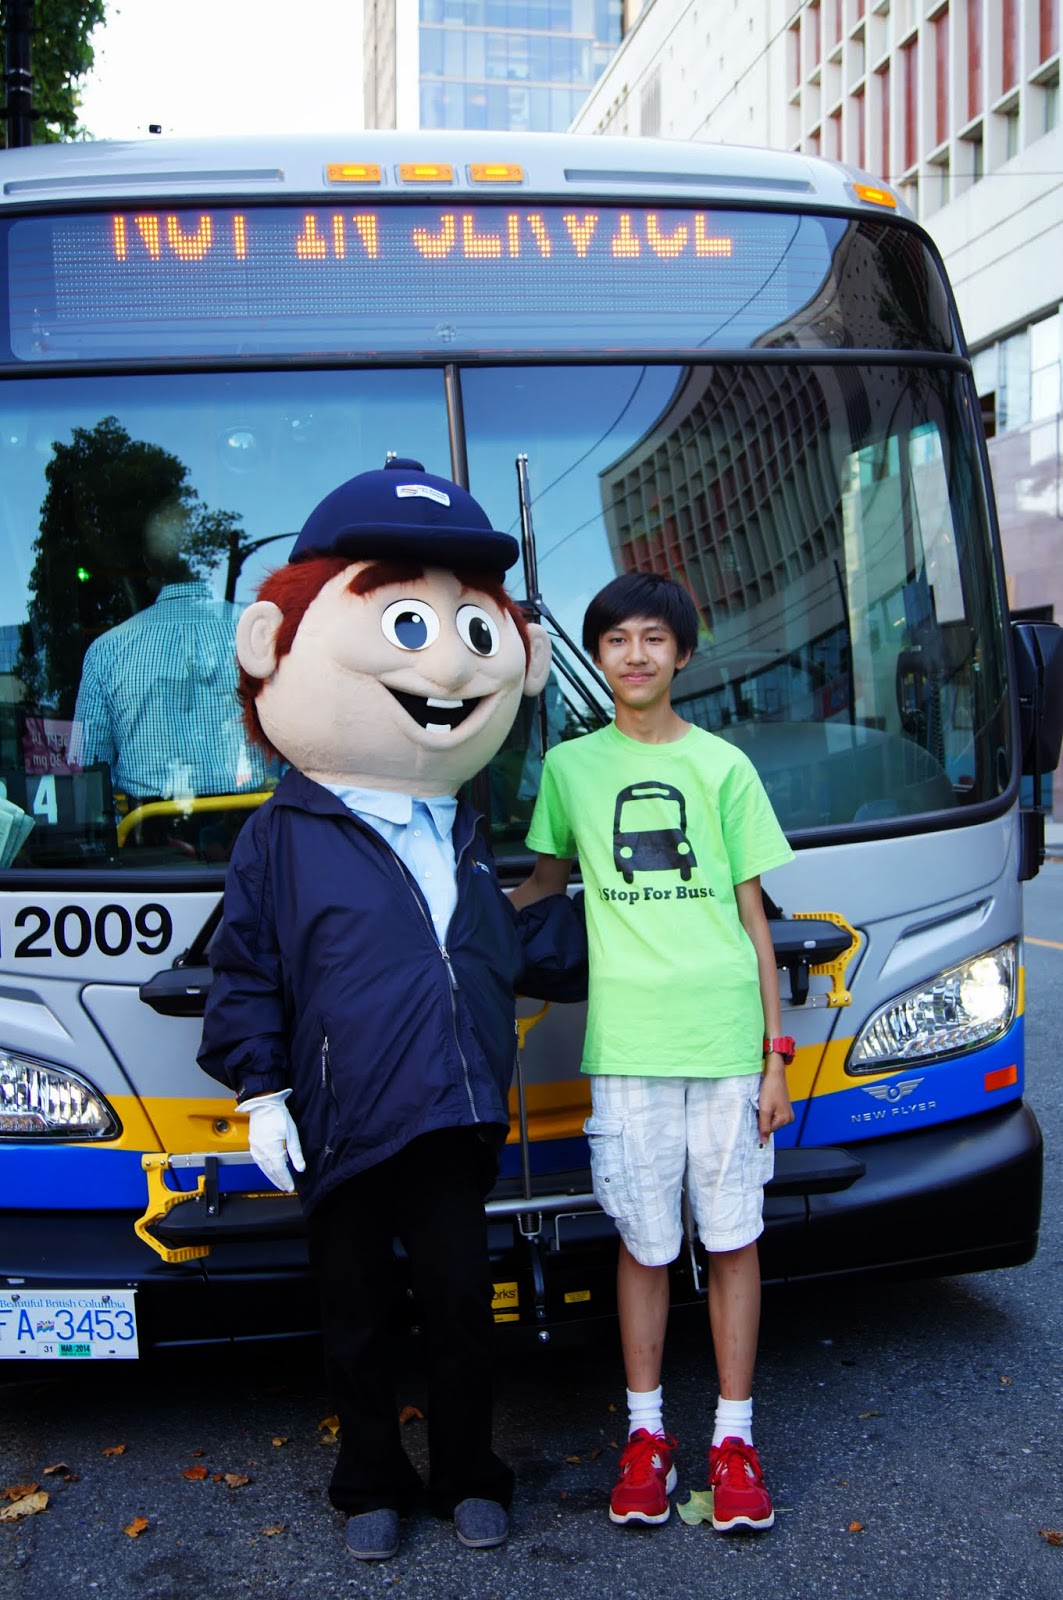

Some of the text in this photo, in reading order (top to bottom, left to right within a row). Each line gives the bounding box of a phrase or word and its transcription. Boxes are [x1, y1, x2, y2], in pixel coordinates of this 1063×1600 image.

[643, 886, 672, 901] For
[0, 902, 173, 959] 2009
[851, 1100, 936, 1123] NEW FLYER
[0, 1299, 126, 1309] Beautiful British Columbia
[55, 1308, 135, 1341] 3453
